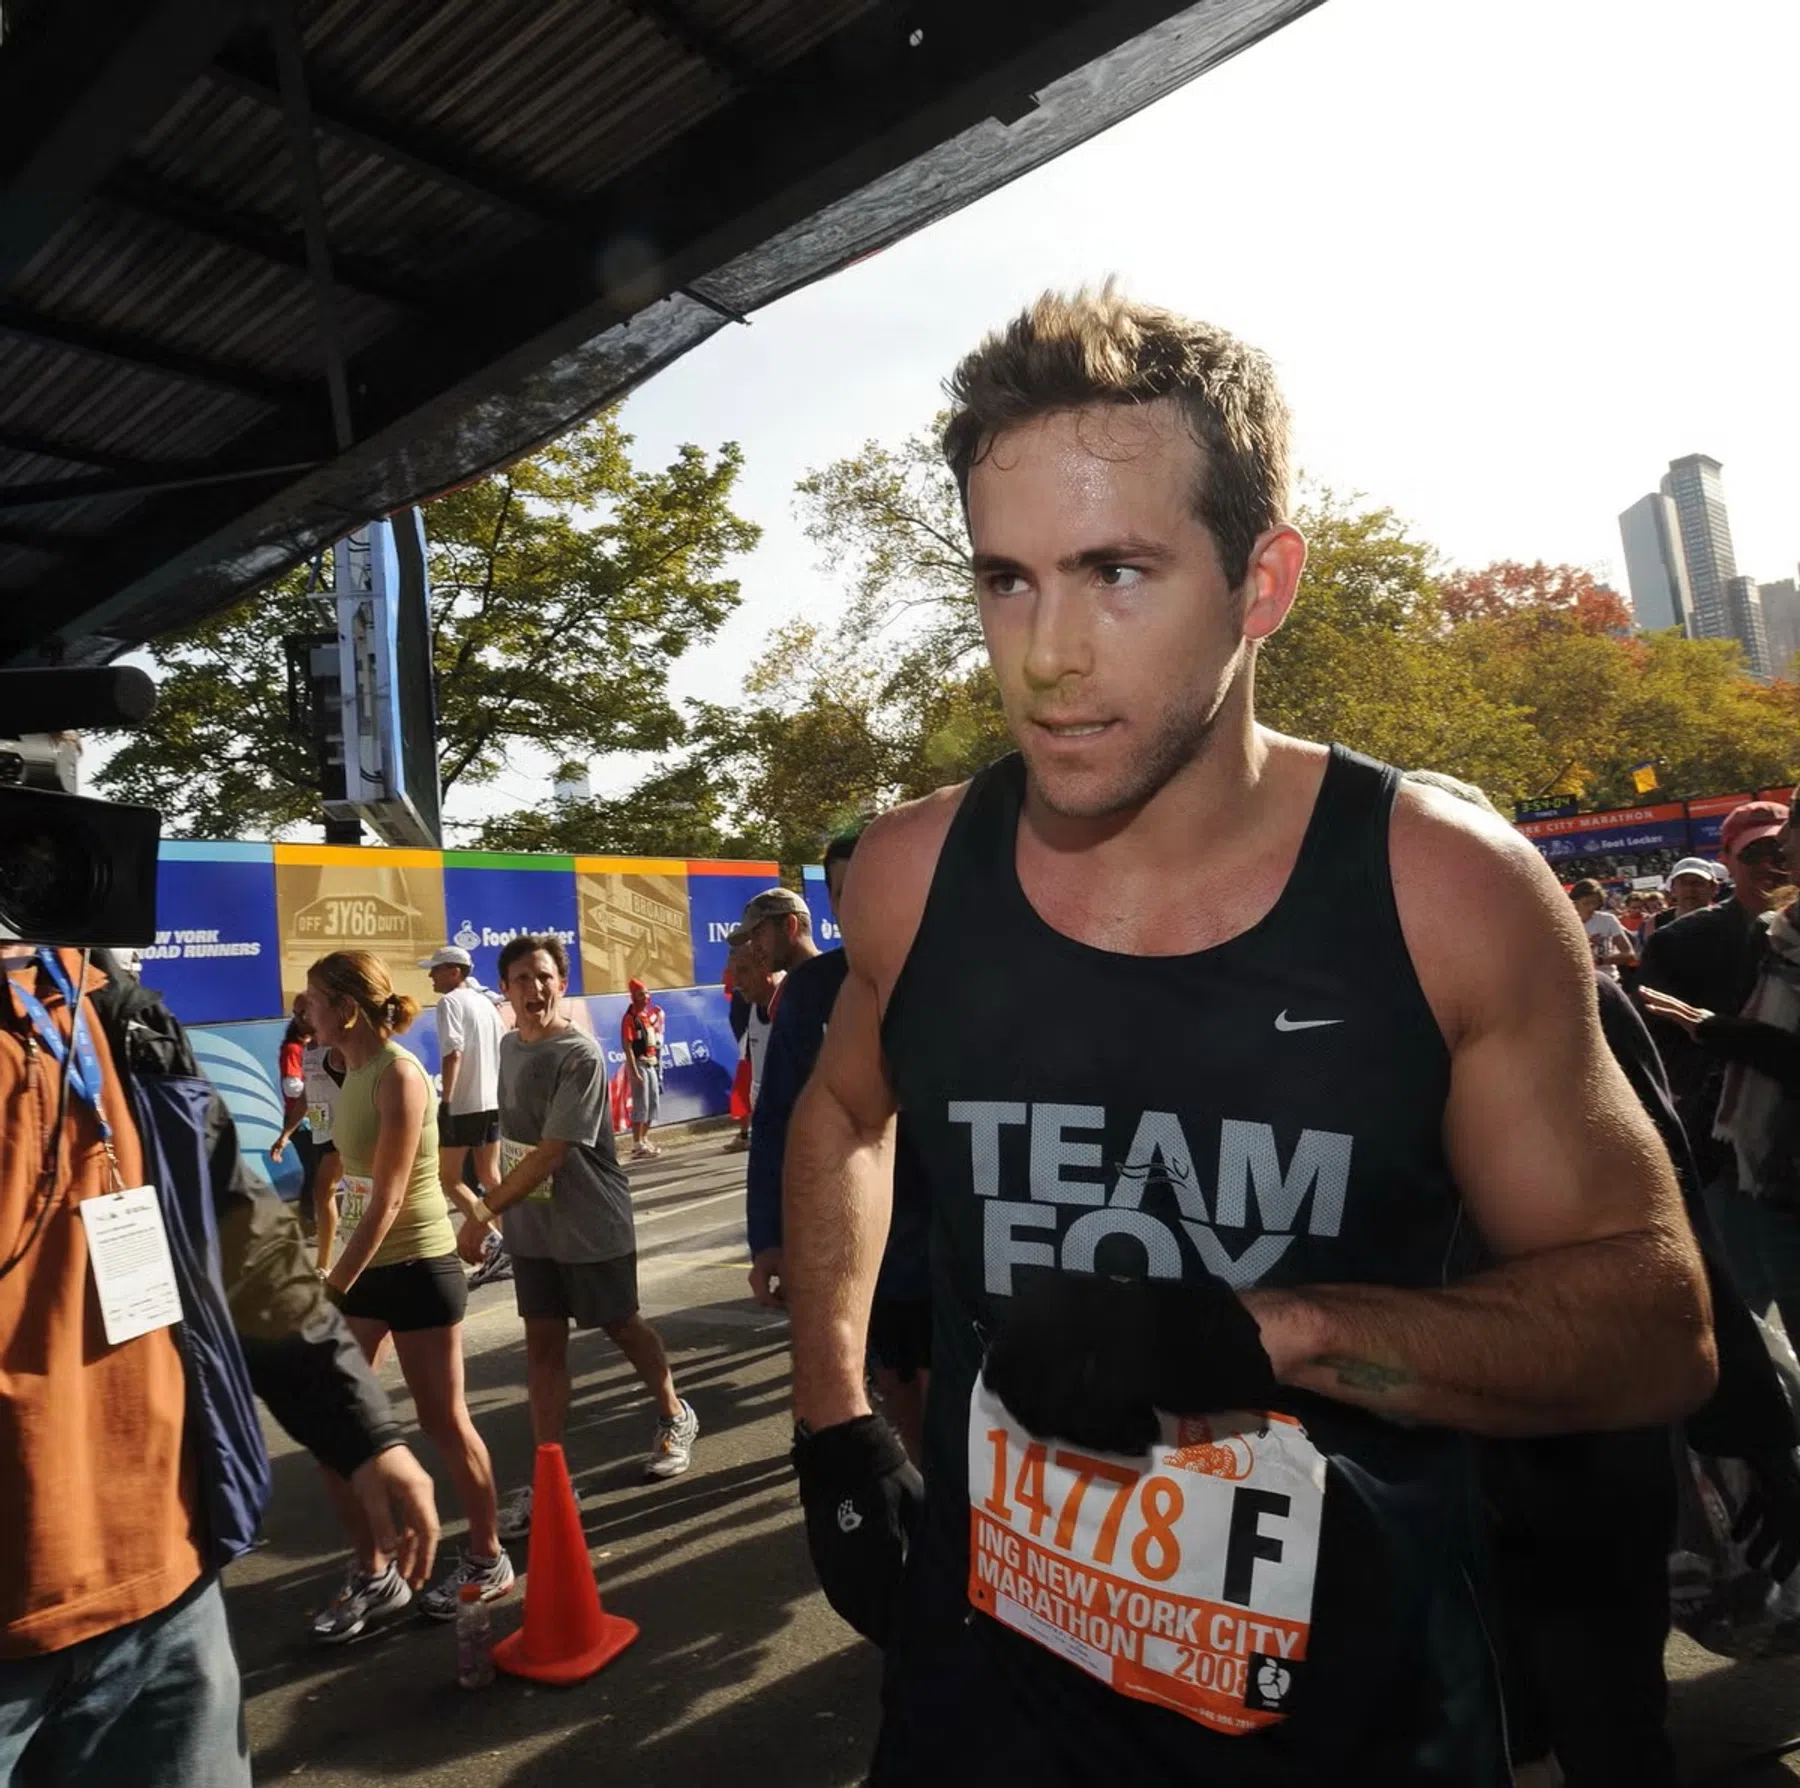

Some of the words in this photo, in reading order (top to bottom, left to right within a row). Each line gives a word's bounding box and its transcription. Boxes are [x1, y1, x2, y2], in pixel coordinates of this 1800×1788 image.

[1547, 820, 1575, 833] CITY
[1579, 809, 1654, 828] MARATHON
[174, 929, 220, 944] YORK
[182, 942, 262, 959] RUNNERS
[299, 915, 323, 932] OFF
[324, 900, 378, 937] 3Y66
[378, 914, 407, 933] DUTY
[947, 1099, 1355, 1238] TEAM
[983, 1427, 1185, 1582] 14778
[1222, 1486, 1292, 1607] F
[976, 1550, 1136, 1662] MARATHON
[977, 1517, 1021, 1572] ING
[1026, 1548, 1100, 1609] NEW
[1104, 1582, 1201, 1645] YORK
[1209, 1612, 1300, 1661] CITY
